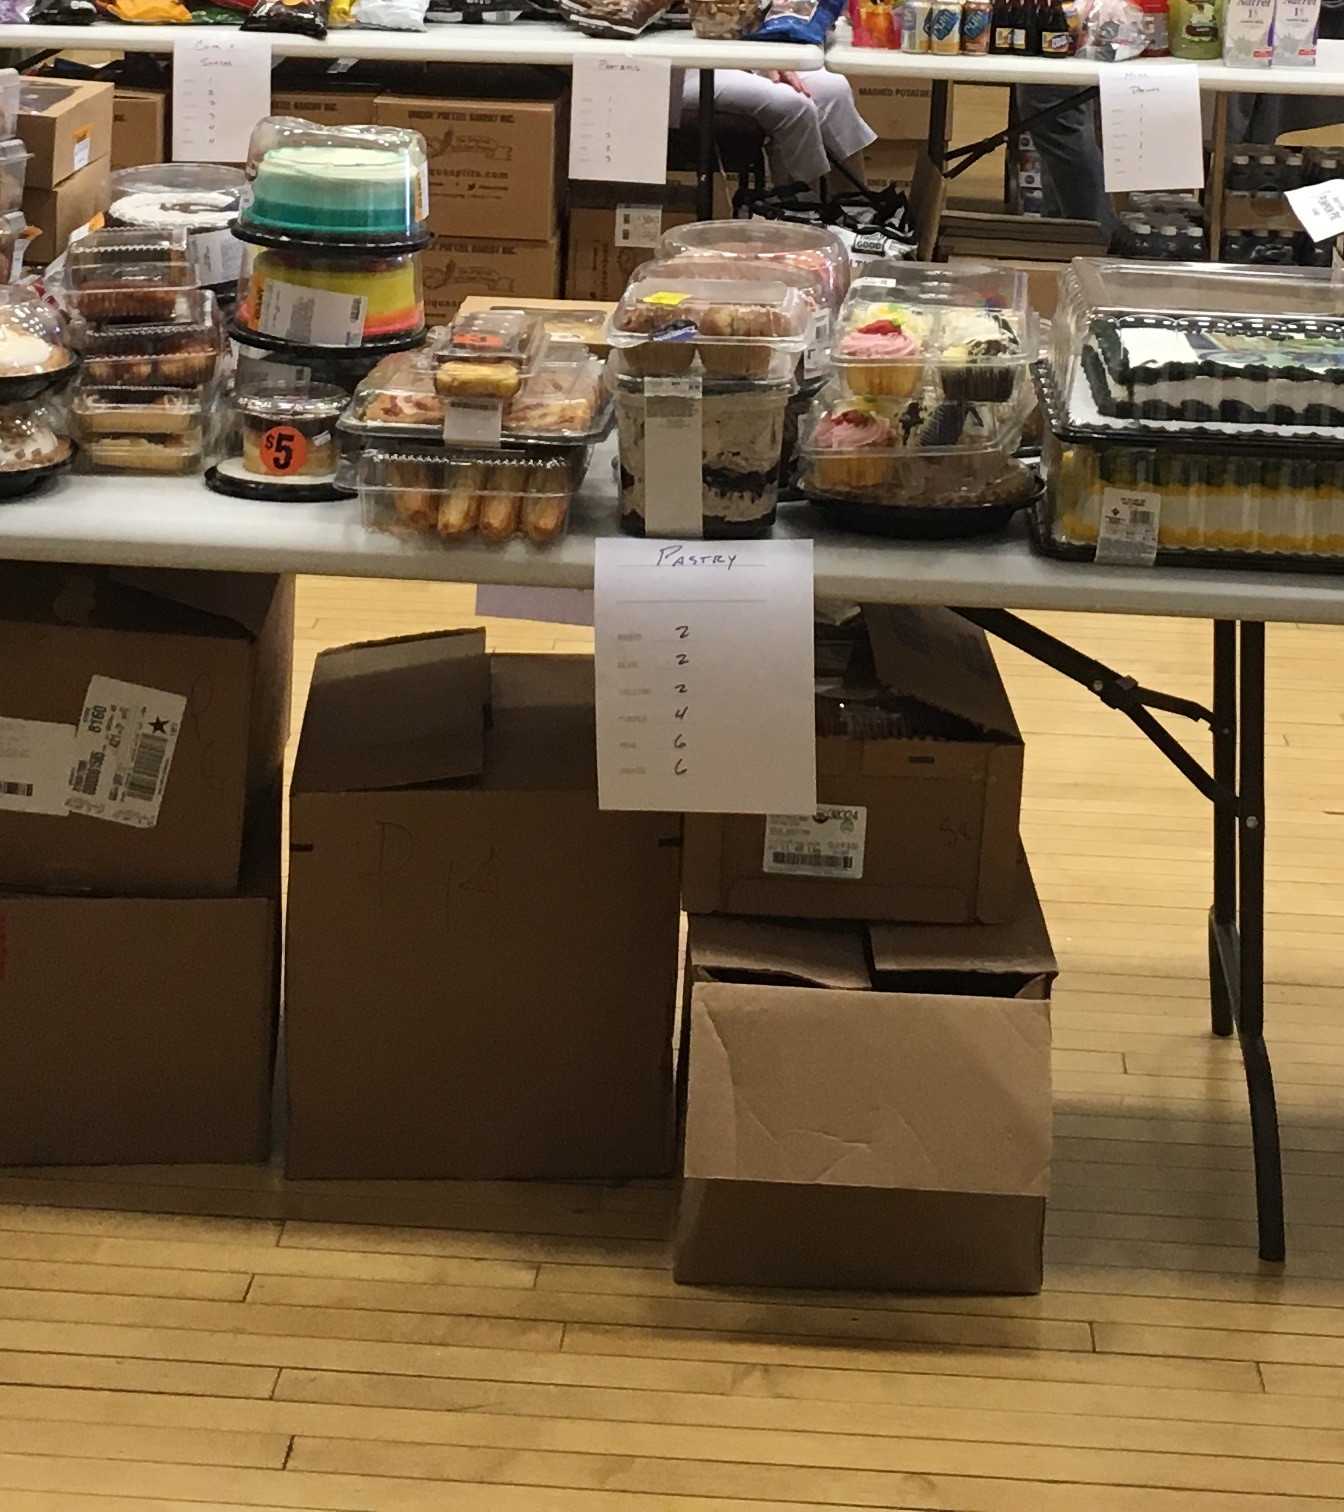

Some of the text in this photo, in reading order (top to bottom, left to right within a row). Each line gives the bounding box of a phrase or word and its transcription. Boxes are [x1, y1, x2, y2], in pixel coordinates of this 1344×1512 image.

[857, 240, 882, 250] GOOD
[264, 430, 294, 472] $5
[675, 625, 690, 639] 2
[675, 653, 690, 666] 2
[674, 684, 688, 694] 2
[674, 706, 689, 720] 4
[673, 734, 687, 749] 6
[674, 758, 688, 776] 6
